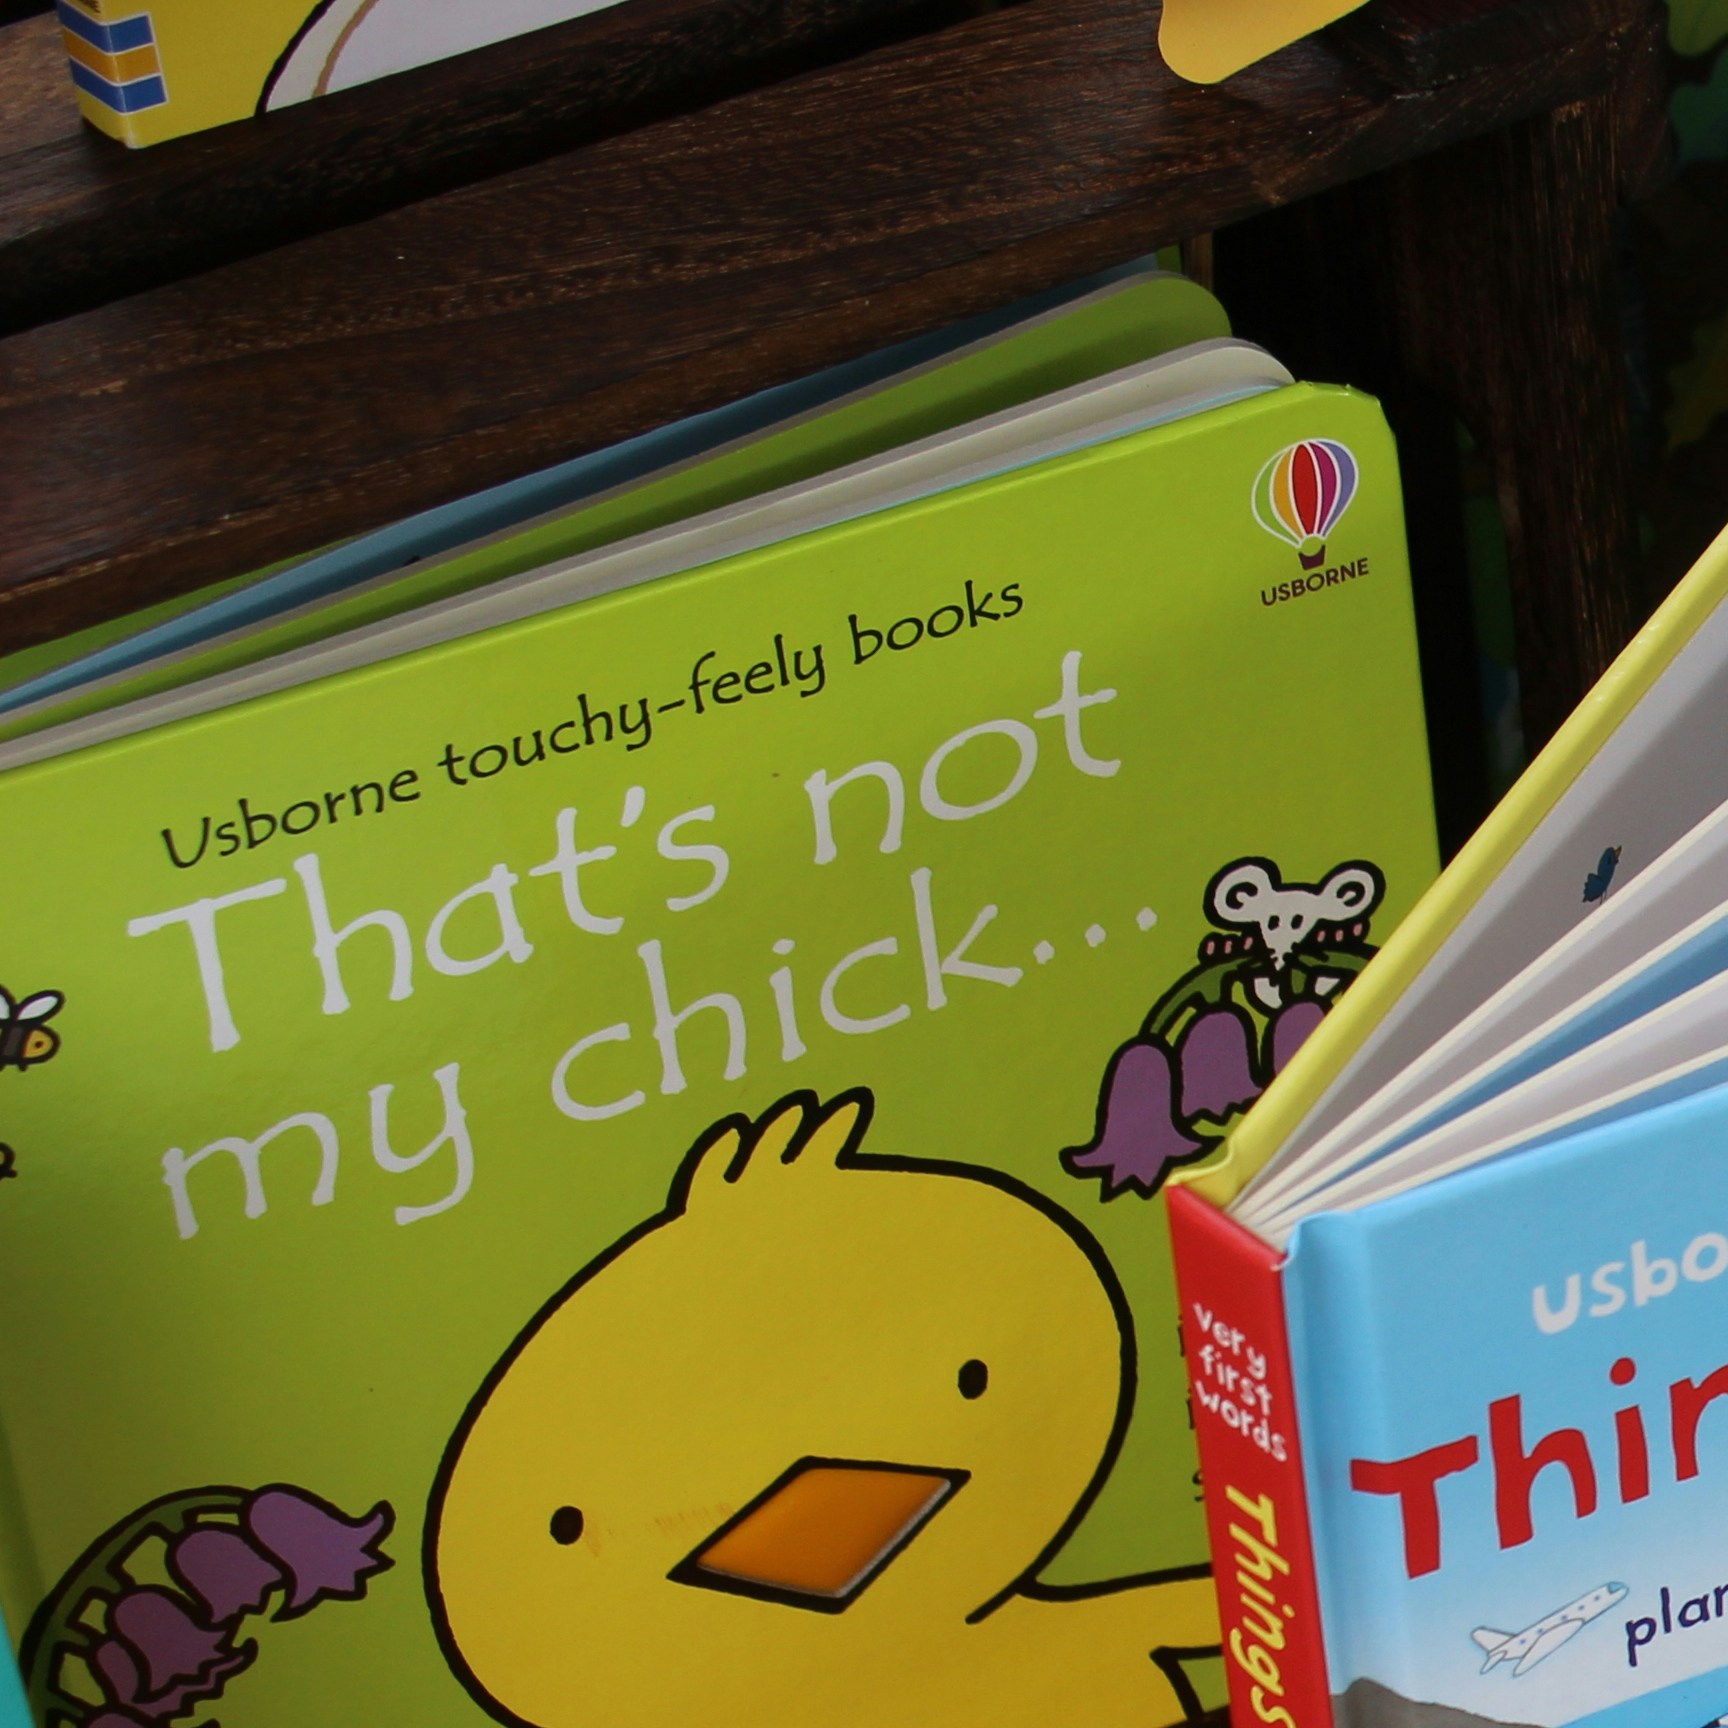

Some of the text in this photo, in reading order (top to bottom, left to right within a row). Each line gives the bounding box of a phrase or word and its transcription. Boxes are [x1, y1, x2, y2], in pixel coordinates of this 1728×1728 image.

[1259, 557, 1371, 607] USBORNE
[159, 578, 1024, 870] Usborne touchy-feely books
[127, 650, 1121, 1053] That's not
[161, 865, 1158, 1241] my chick...
[1193, 1301, 1267, 1380] very
[1199, 1344, 1273, 1417] first
[1195, 1379, 1288, 1463] words
